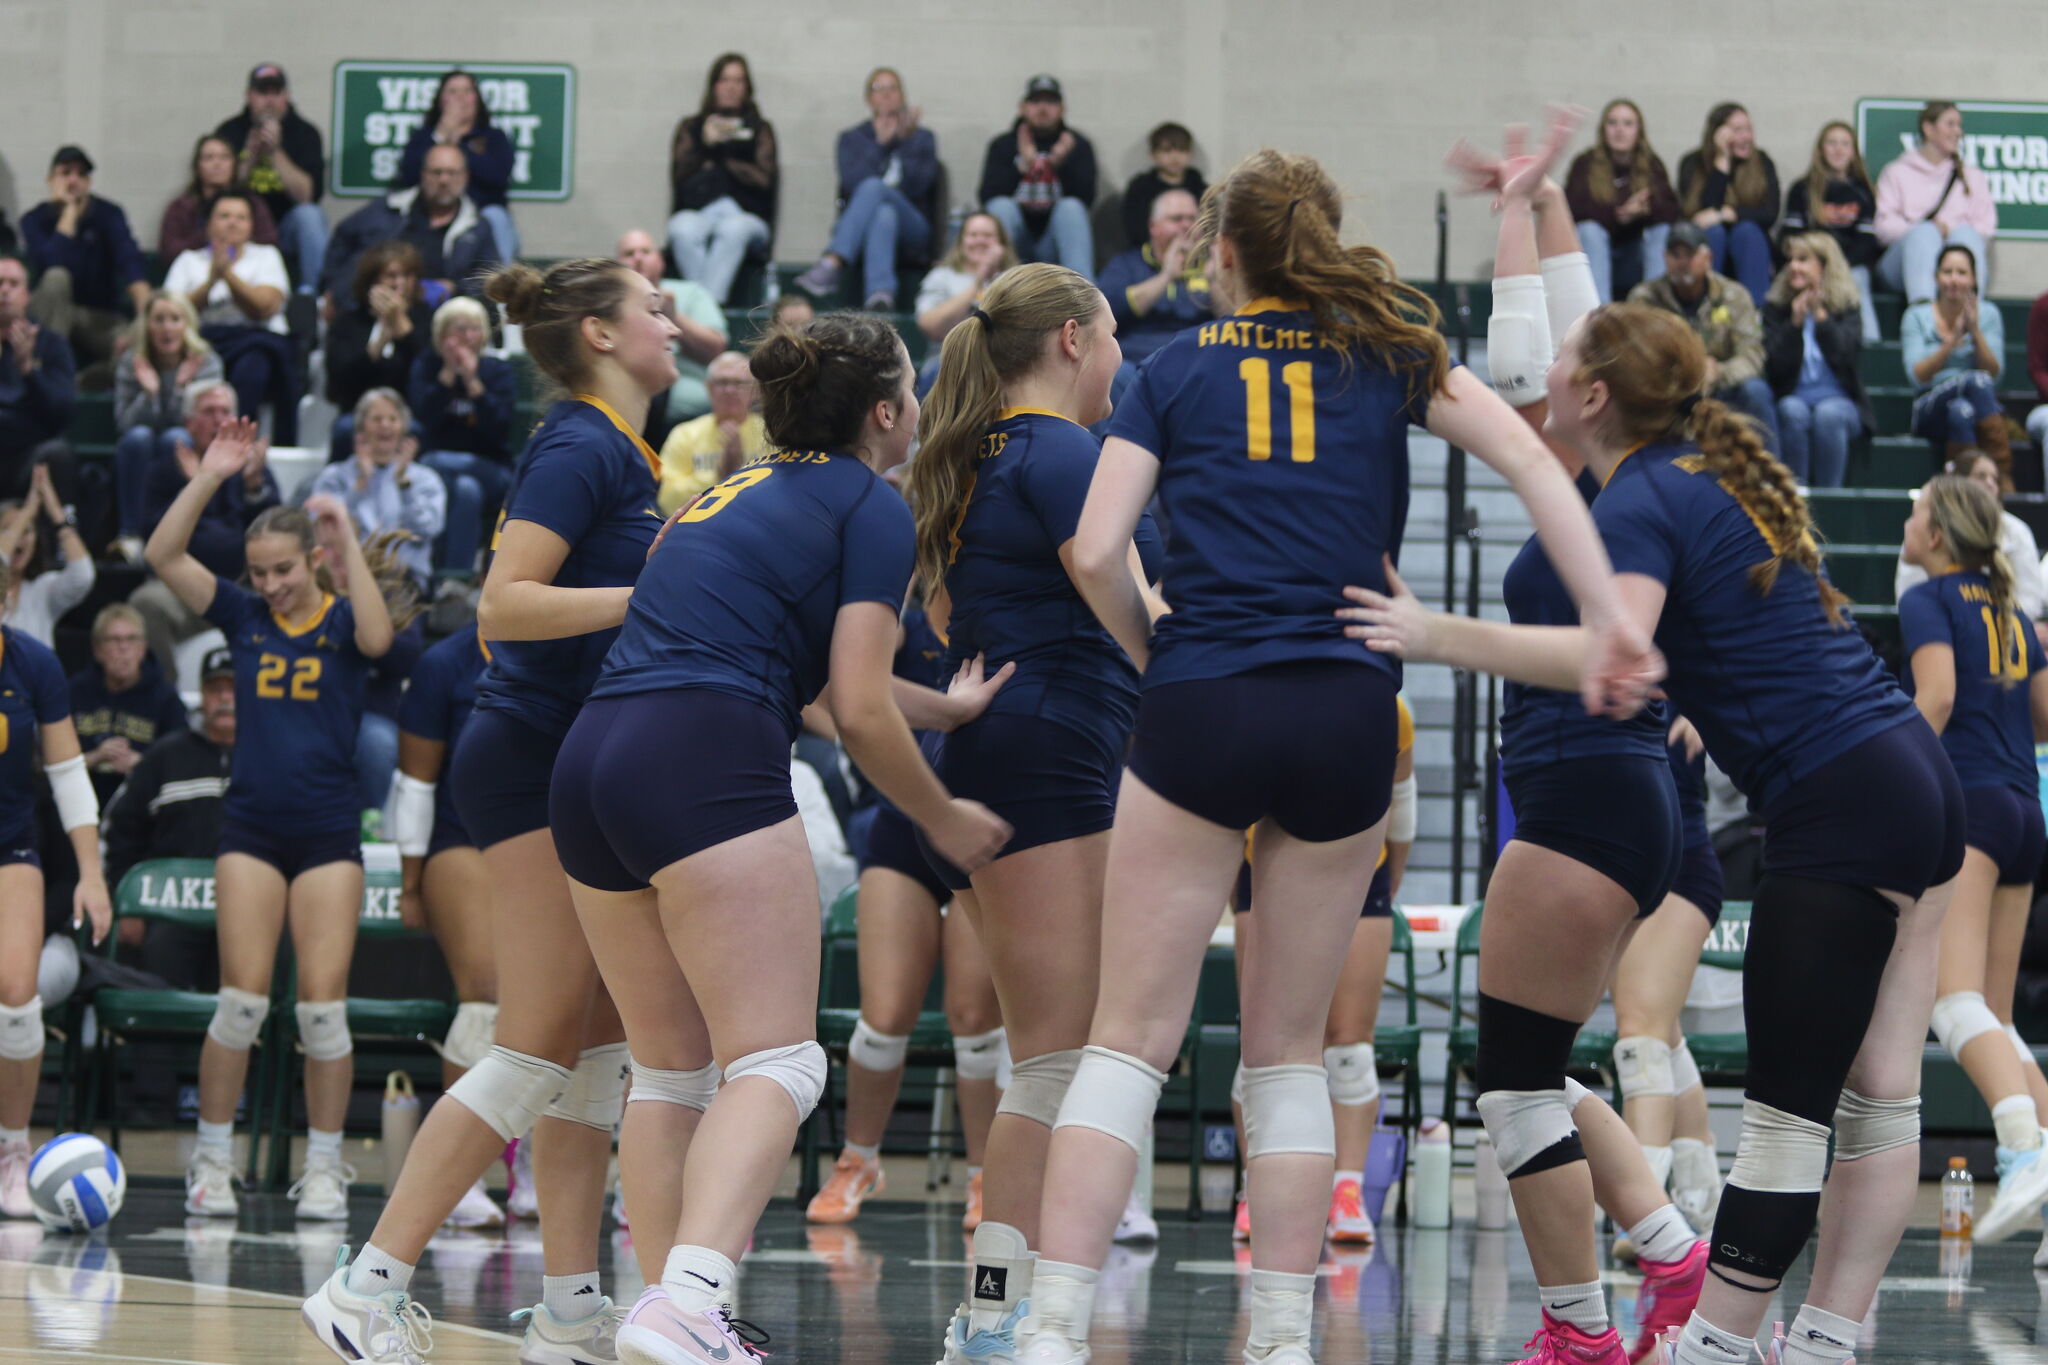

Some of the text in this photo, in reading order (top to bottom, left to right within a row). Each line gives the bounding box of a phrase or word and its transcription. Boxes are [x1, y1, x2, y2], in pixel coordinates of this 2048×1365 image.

[1198, 320, 1349, 350] HATCHE
[1239, 357, 1315, 462] 11
[677, 467, 773, 523] 8
[256, 654, 323, 700] 22
